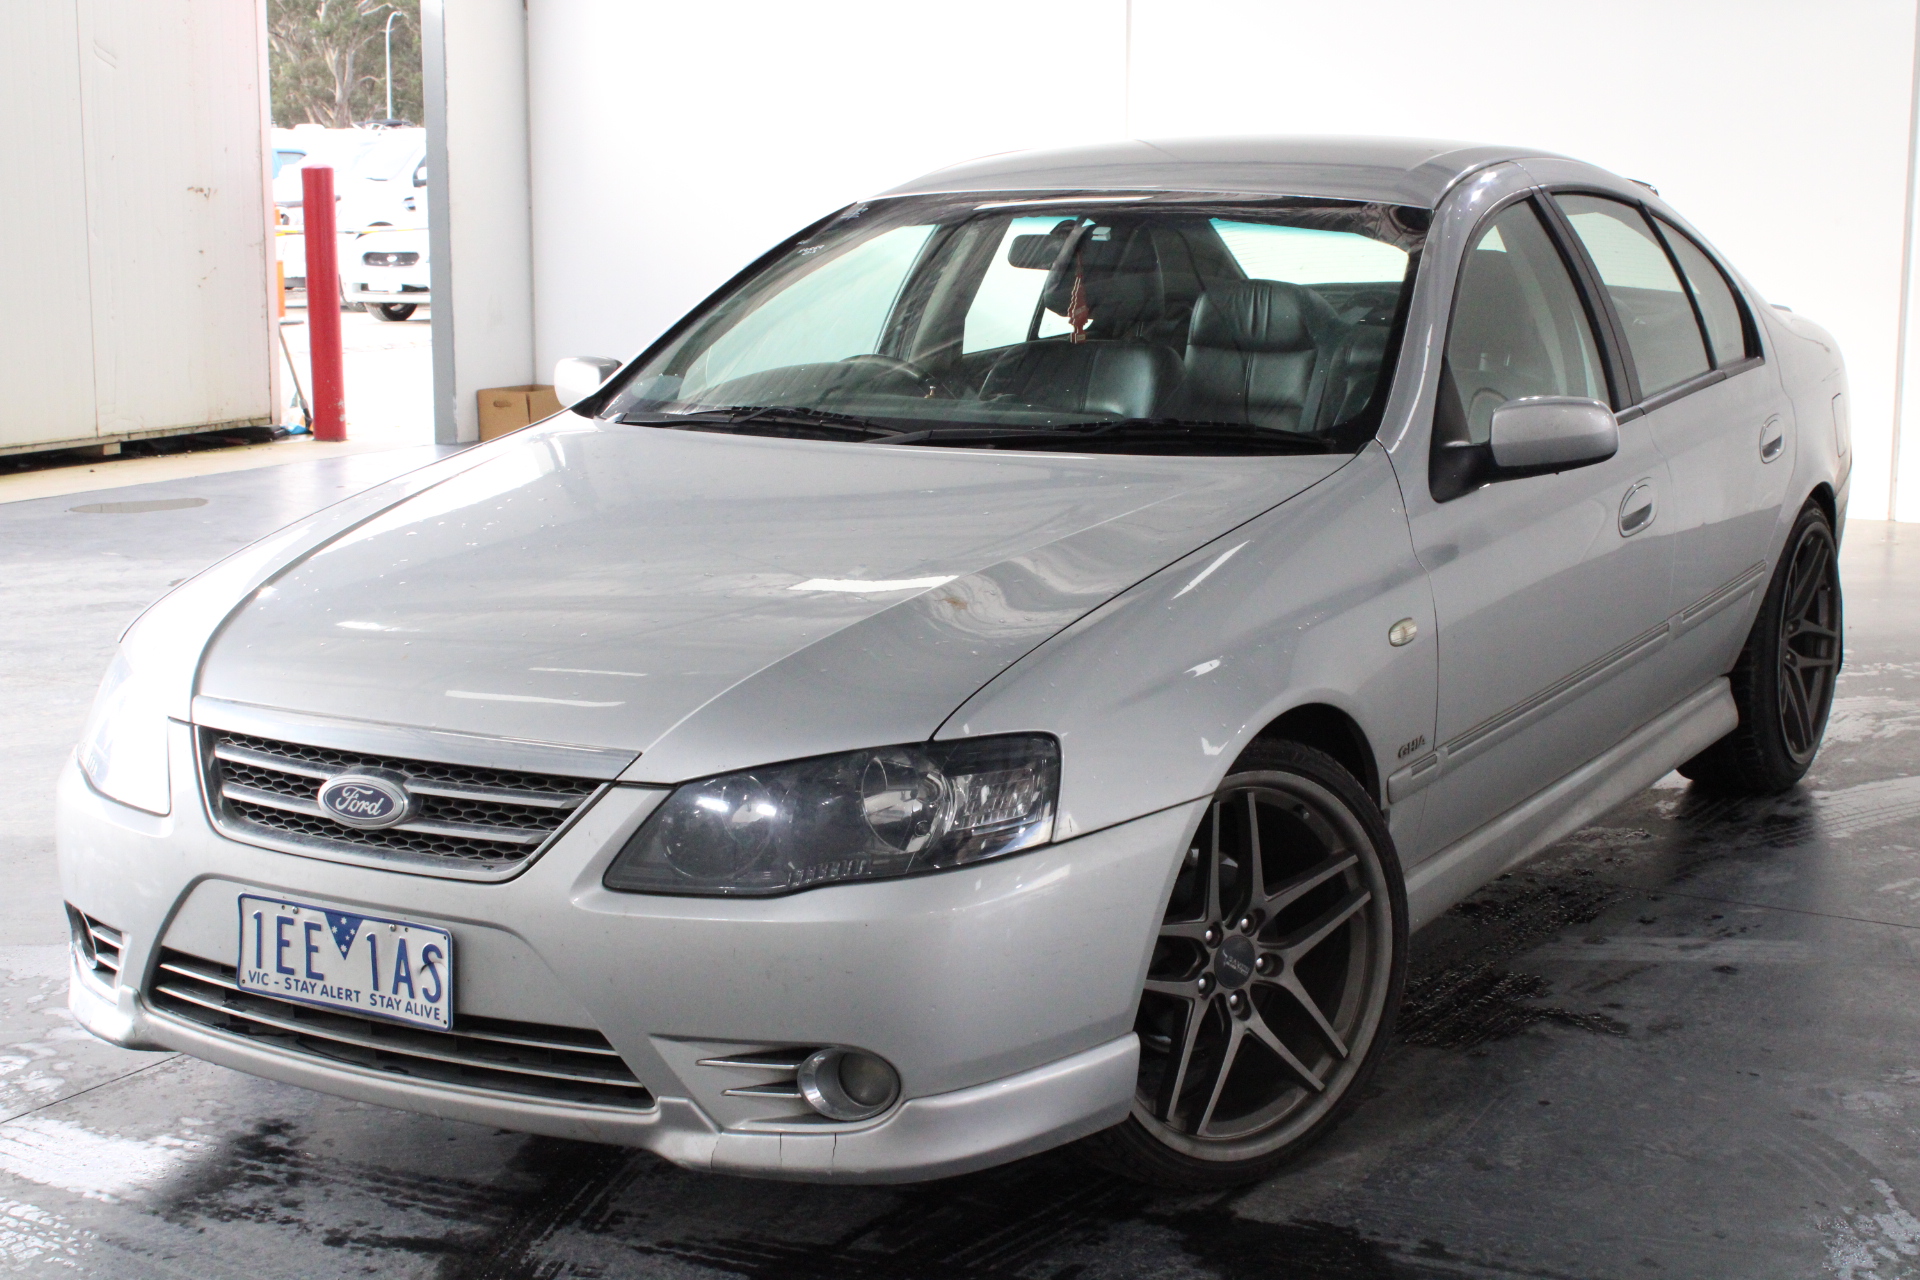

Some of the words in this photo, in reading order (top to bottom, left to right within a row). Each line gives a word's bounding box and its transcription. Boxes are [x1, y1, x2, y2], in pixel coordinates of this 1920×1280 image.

[335, 785, 385, 816] Ford
[252, 909, 325, 981] 1EE
[365, 931, 444, 1004] 1AS
[248, 970, 270, 987] VIC
[284, 977, 317, 995] STAY
[320, 983, 361, 1003] ALERT
[369, 993, 402, 1011] STAY
[404, 1000, 441, 1021] ALIVE
